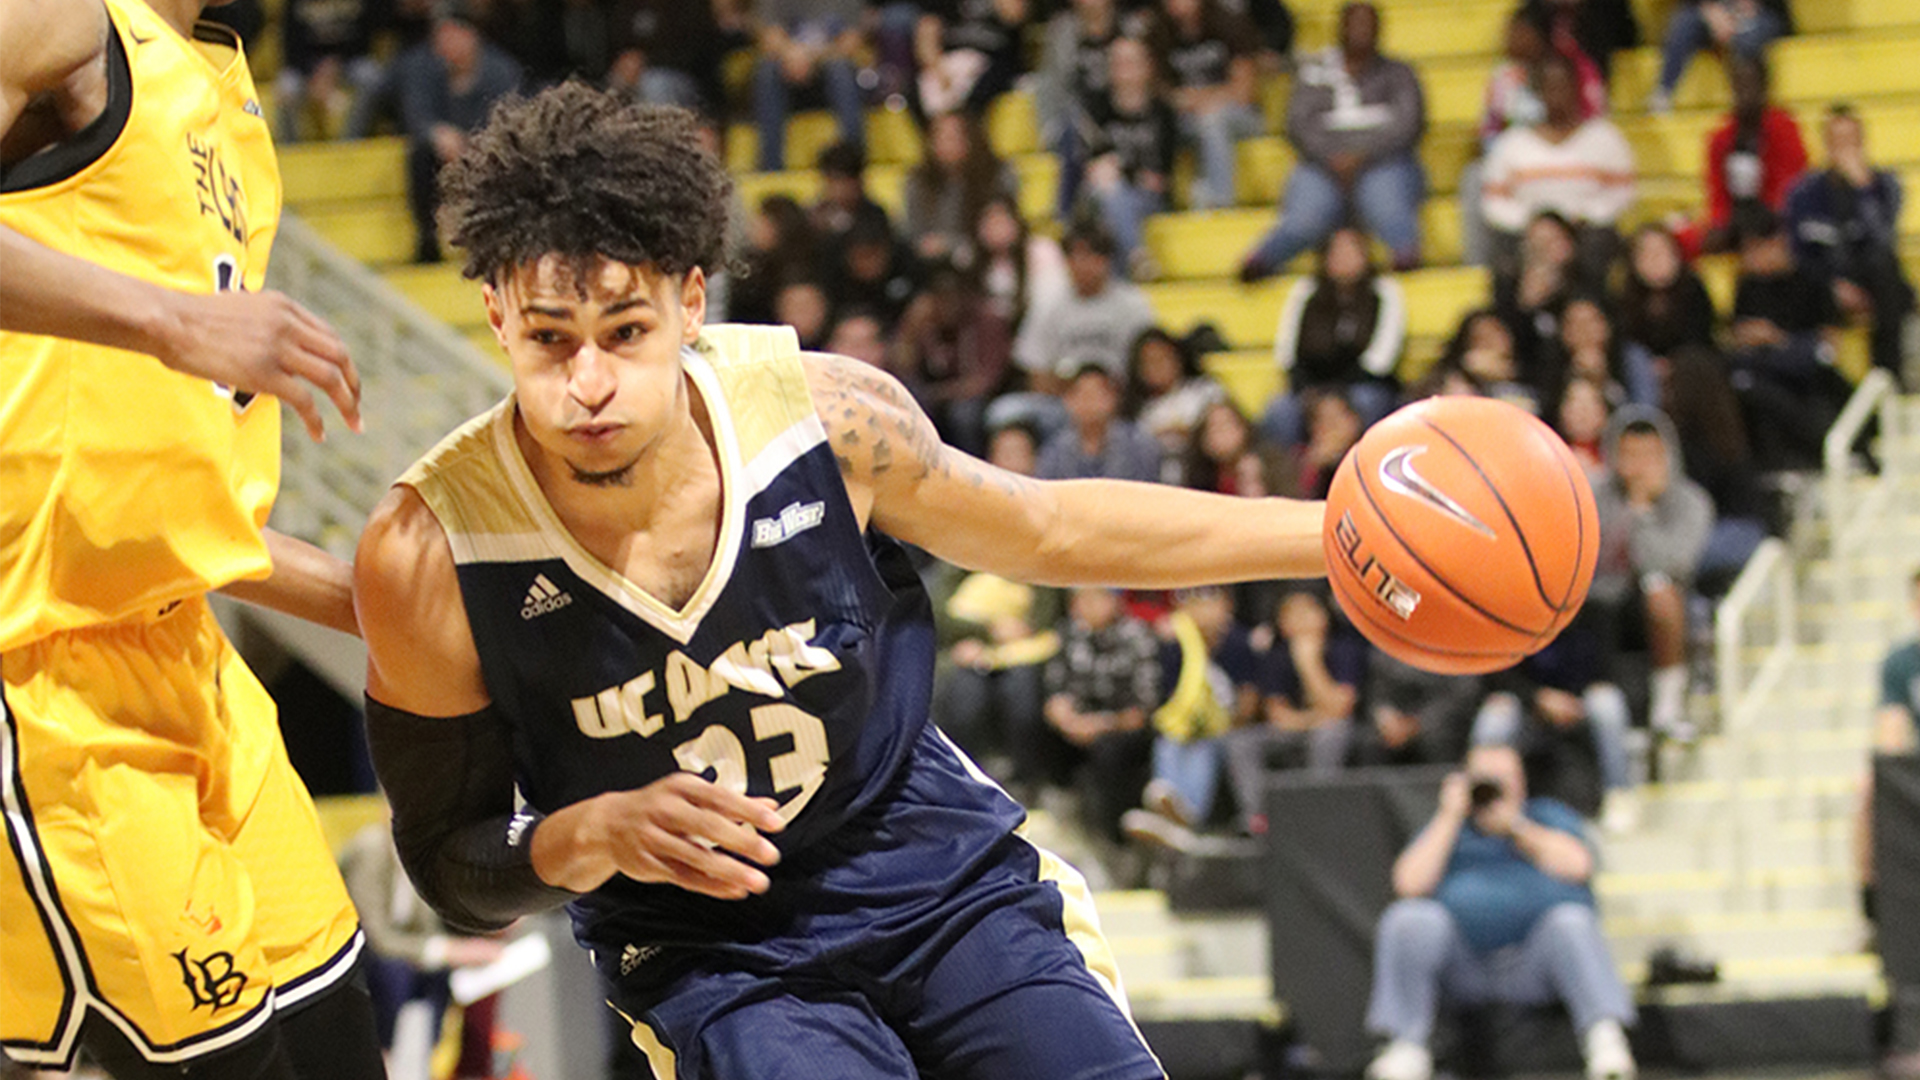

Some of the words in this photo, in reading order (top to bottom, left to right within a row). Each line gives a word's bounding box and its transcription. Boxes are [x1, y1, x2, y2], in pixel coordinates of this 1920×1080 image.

[186, 132, 215, 215] THE
[520, 591, 573, 620] adidas
[1334, 507, 1422, 621] ELITE
[571, 669, 665, 739] UC
[672, 702, 830, 850] 23
